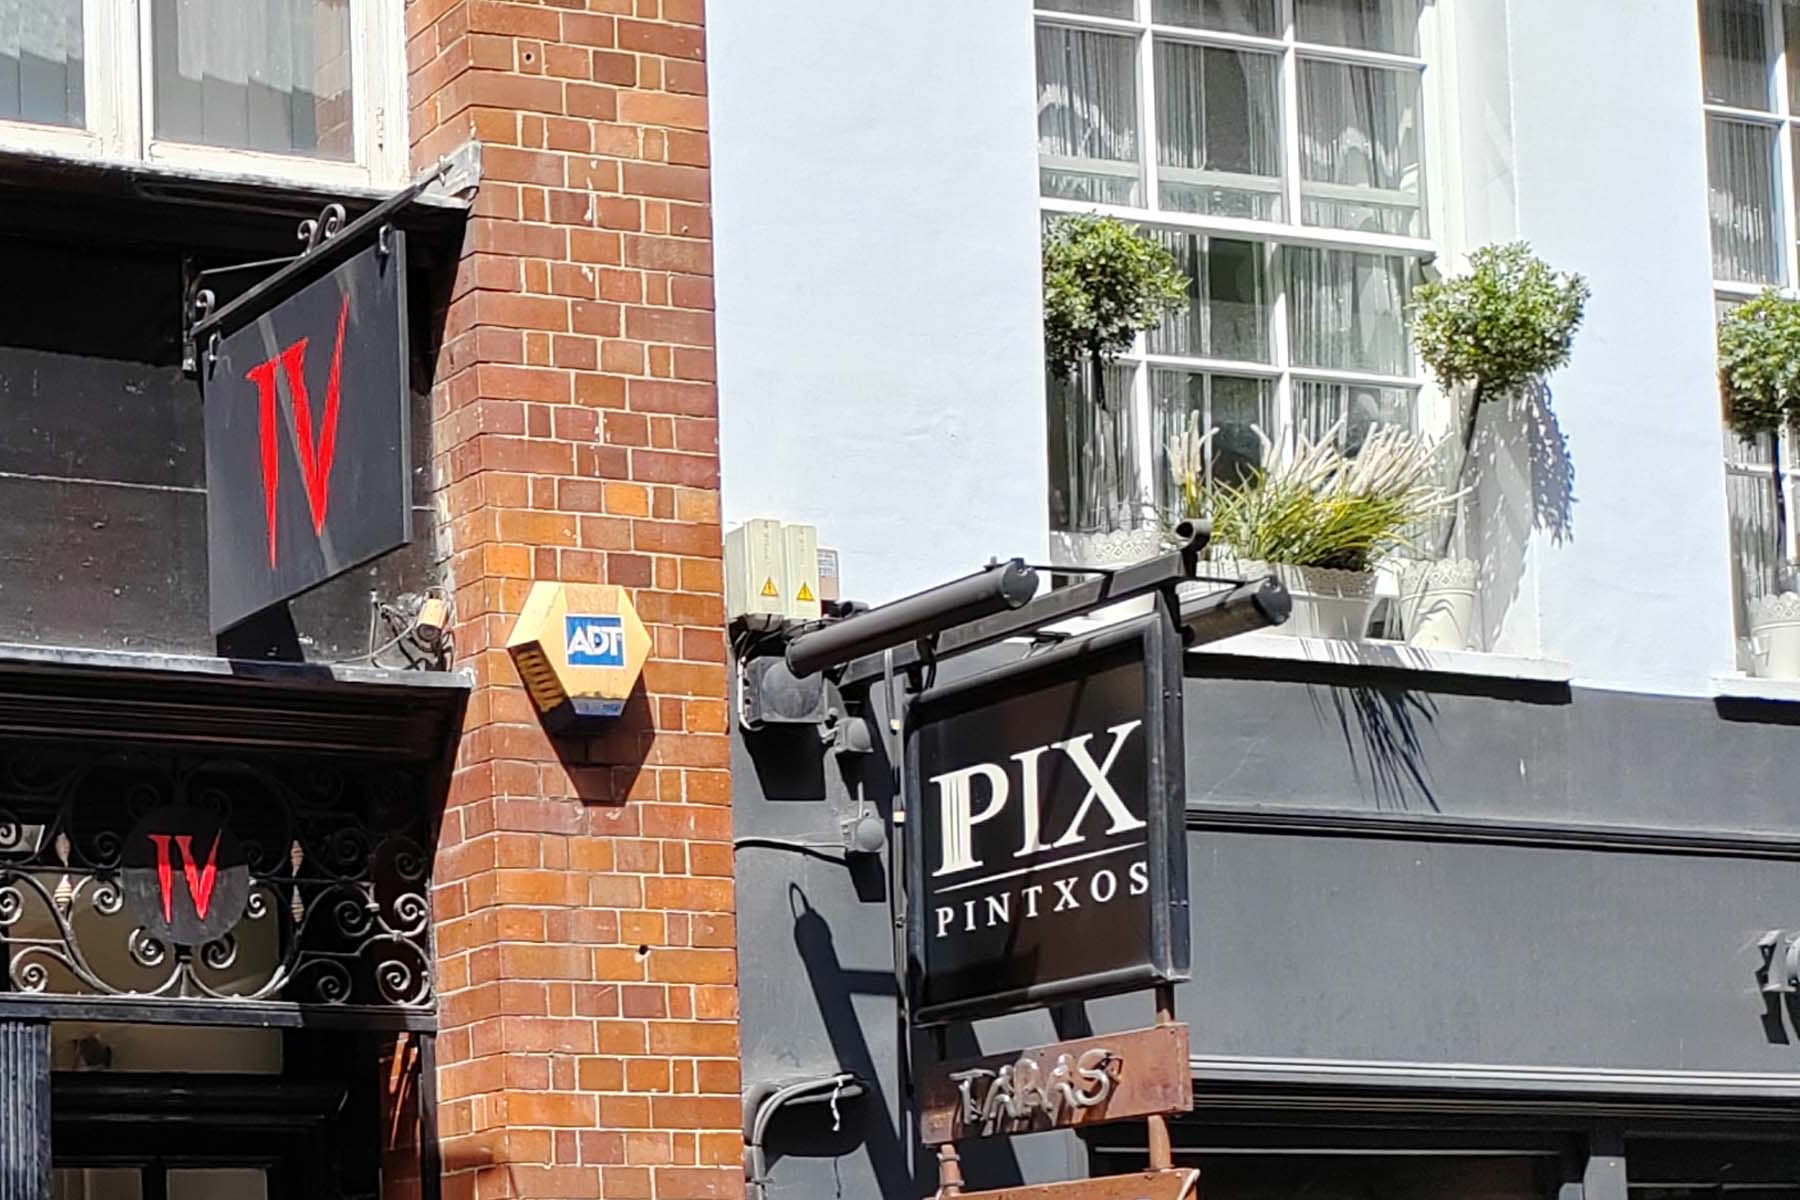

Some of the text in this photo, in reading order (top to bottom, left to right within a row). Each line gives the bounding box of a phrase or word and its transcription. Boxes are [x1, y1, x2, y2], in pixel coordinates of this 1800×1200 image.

[567, 625, 621, 656] ADT
[929, 719, 1146, 878] PIX
[935, 861, 1150, 938] PINTXOS
